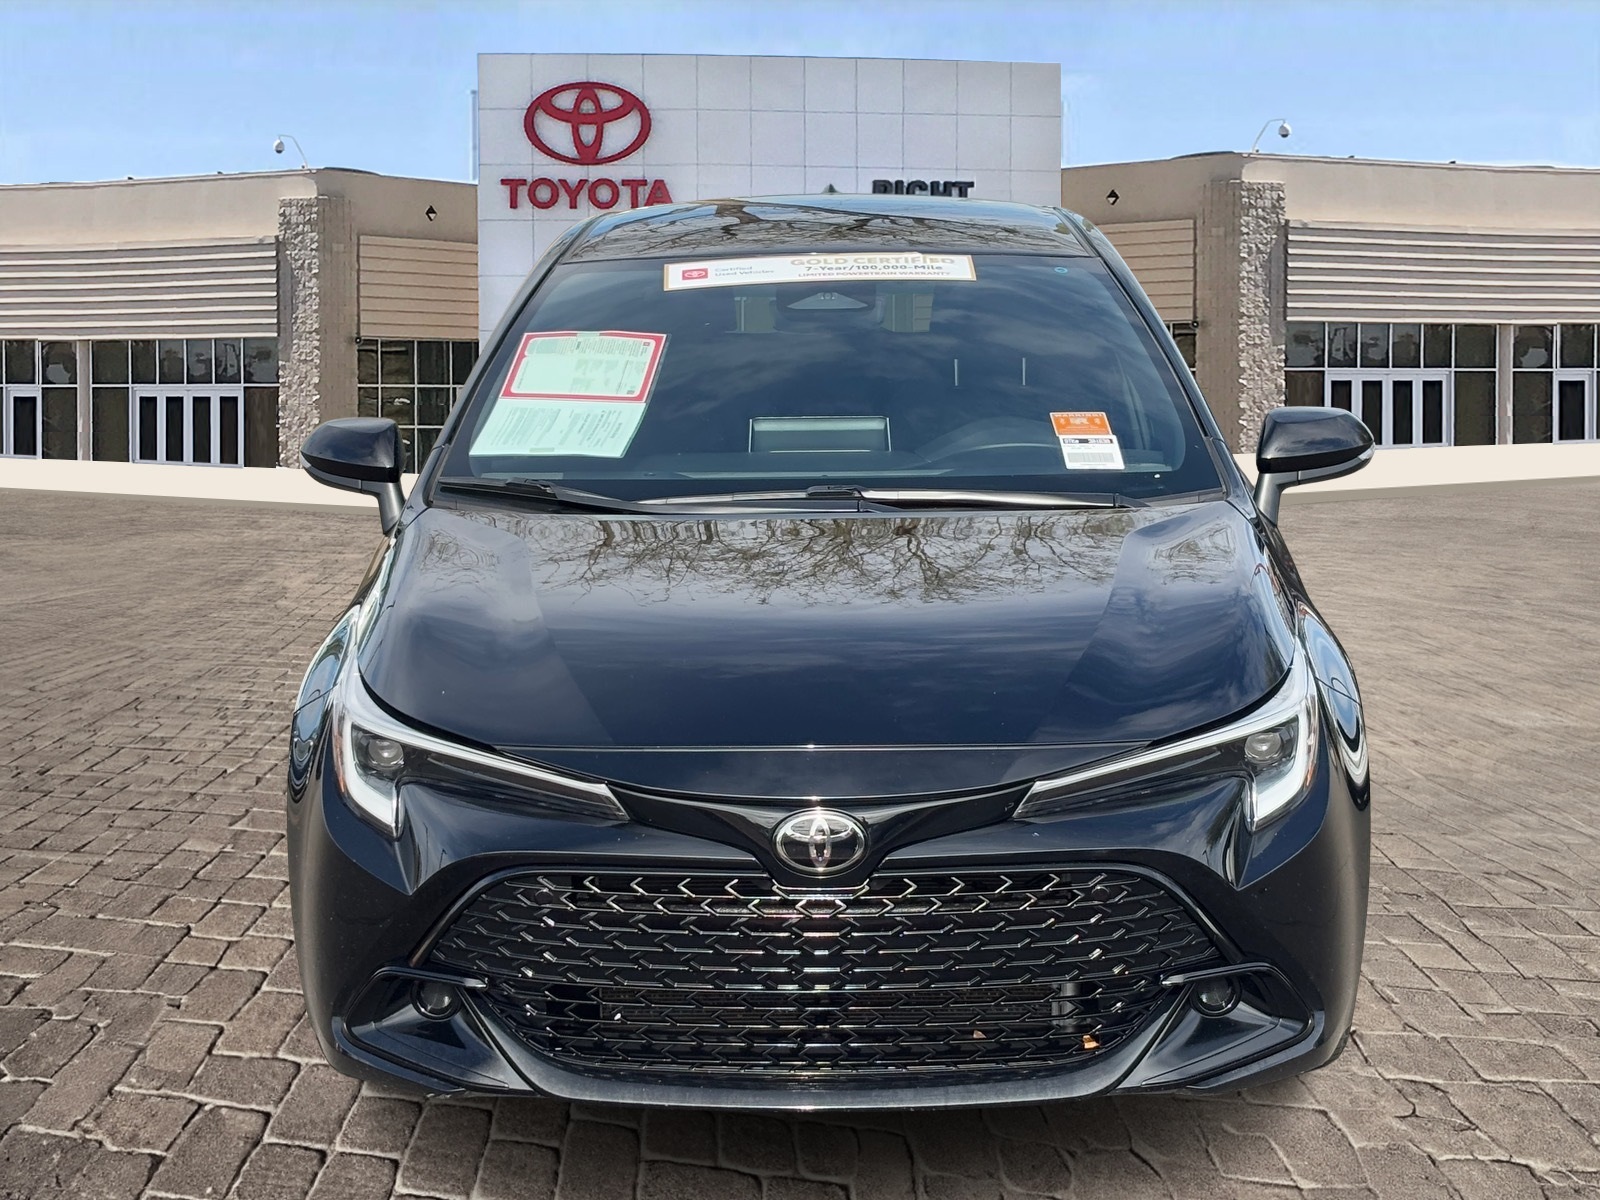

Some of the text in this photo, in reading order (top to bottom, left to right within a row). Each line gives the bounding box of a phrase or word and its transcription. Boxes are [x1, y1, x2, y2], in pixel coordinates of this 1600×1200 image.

[500, 177, 673, 209] TOYOTA
[790, 255, 955, 266] GOLD CERTIFIED
[804, 264, 943, 272] 7-Year/100,000-Mile
